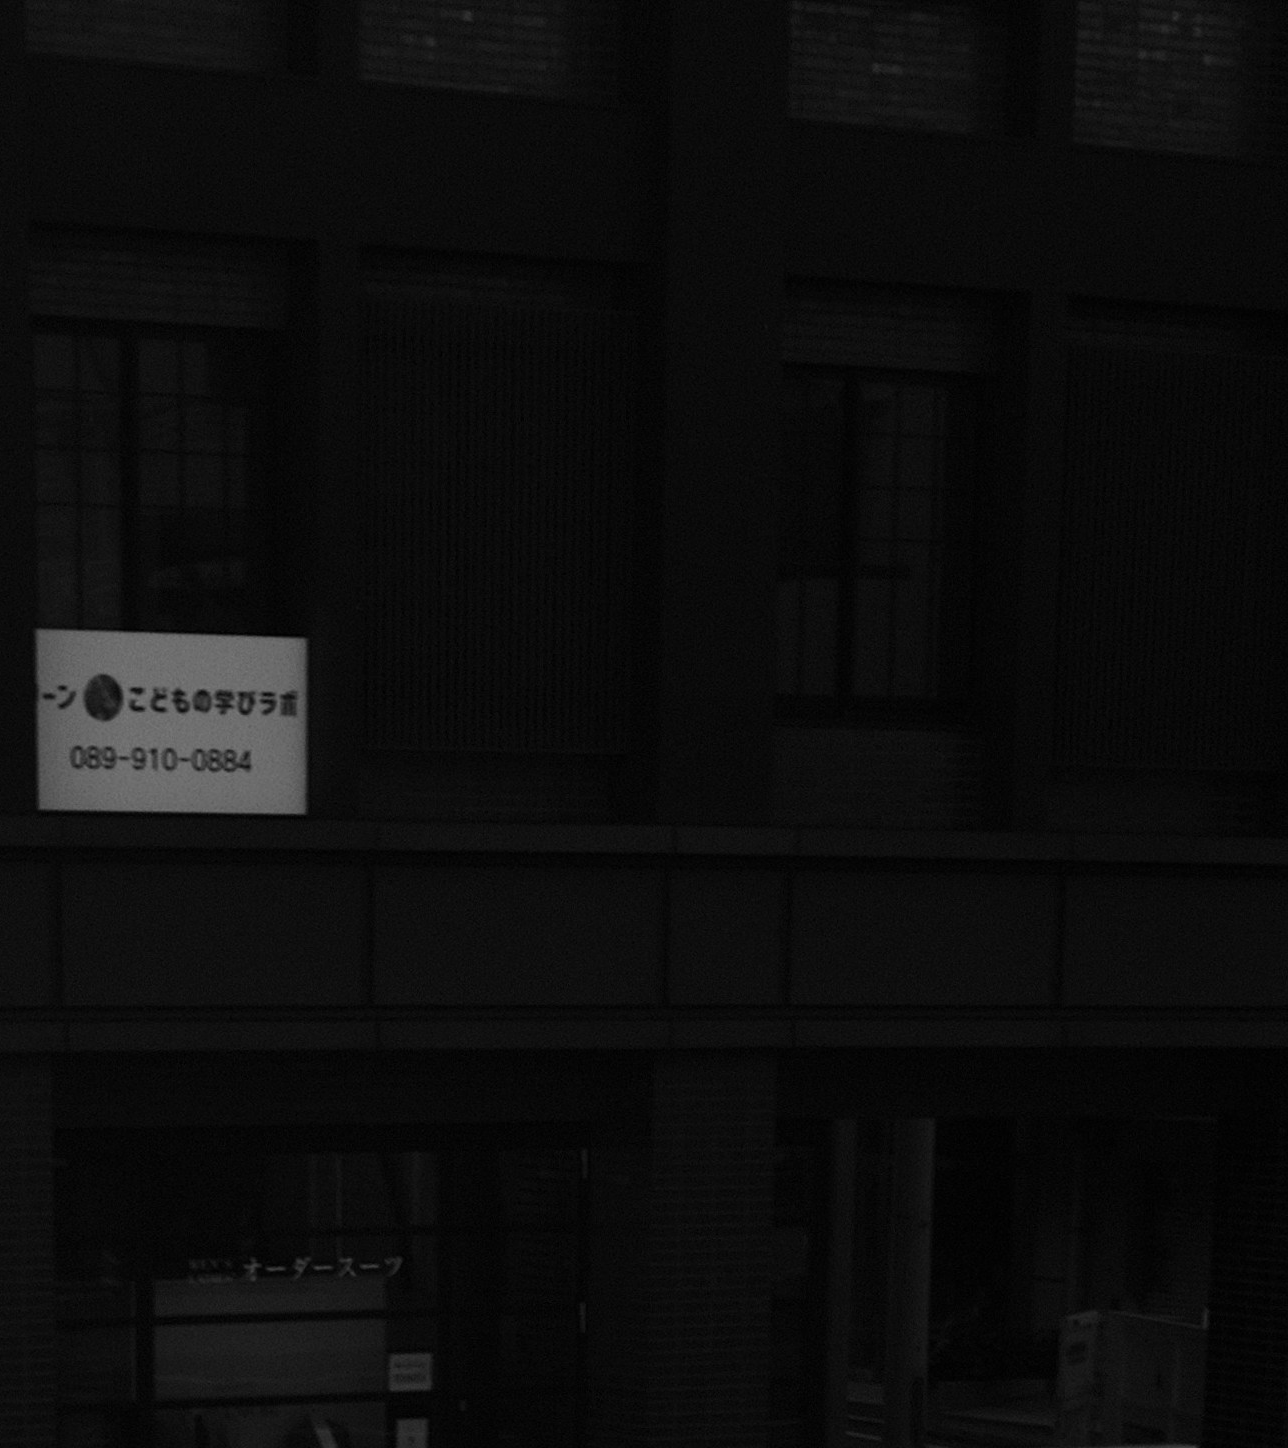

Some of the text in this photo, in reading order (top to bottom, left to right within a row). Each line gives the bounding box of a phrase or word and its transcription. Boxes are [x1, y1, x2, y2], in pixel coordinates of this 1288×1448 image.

[70, 745, 252, 773] 089-910-0884
[243, 1256, 404, 1283] オーダースーツ
